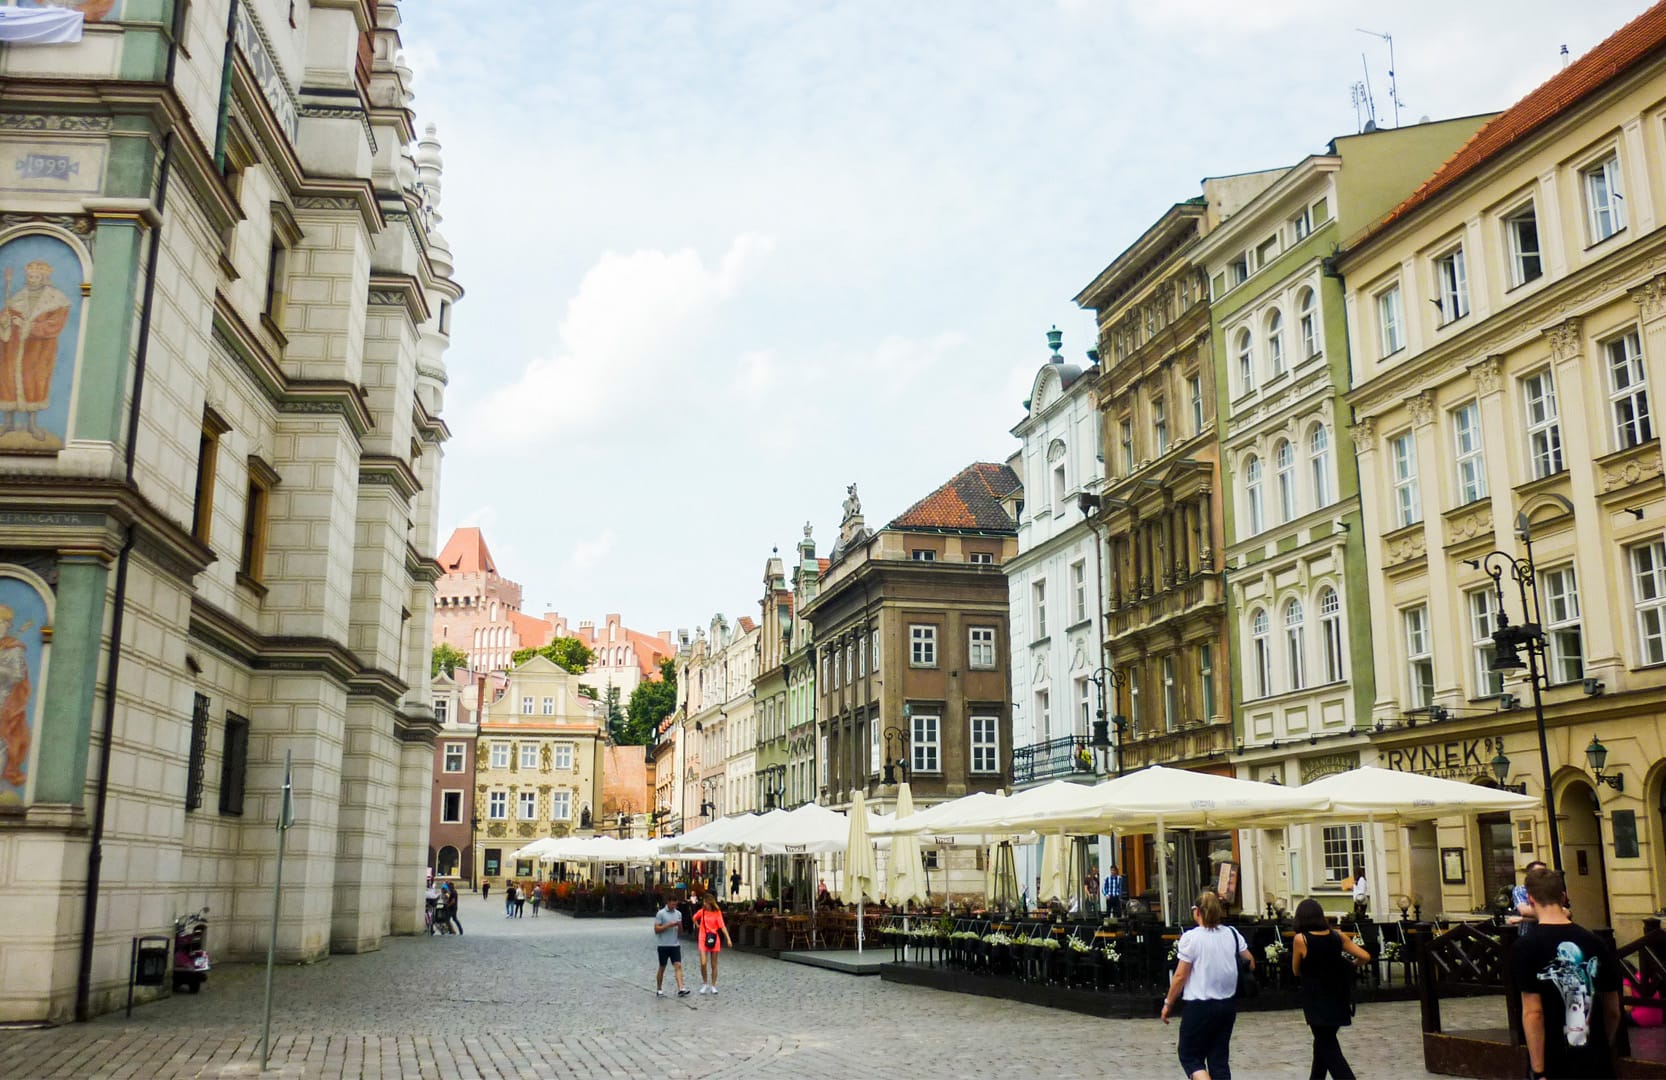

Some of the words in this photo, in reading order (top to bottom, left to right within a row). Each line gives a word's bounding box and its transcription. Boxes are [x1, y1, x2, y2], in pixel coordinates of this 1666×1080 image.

[28, 156, 66, 174] 1999
[1388, 739, 1482, 772] RYNEK
[1485, 736, 1504, 753] 95
